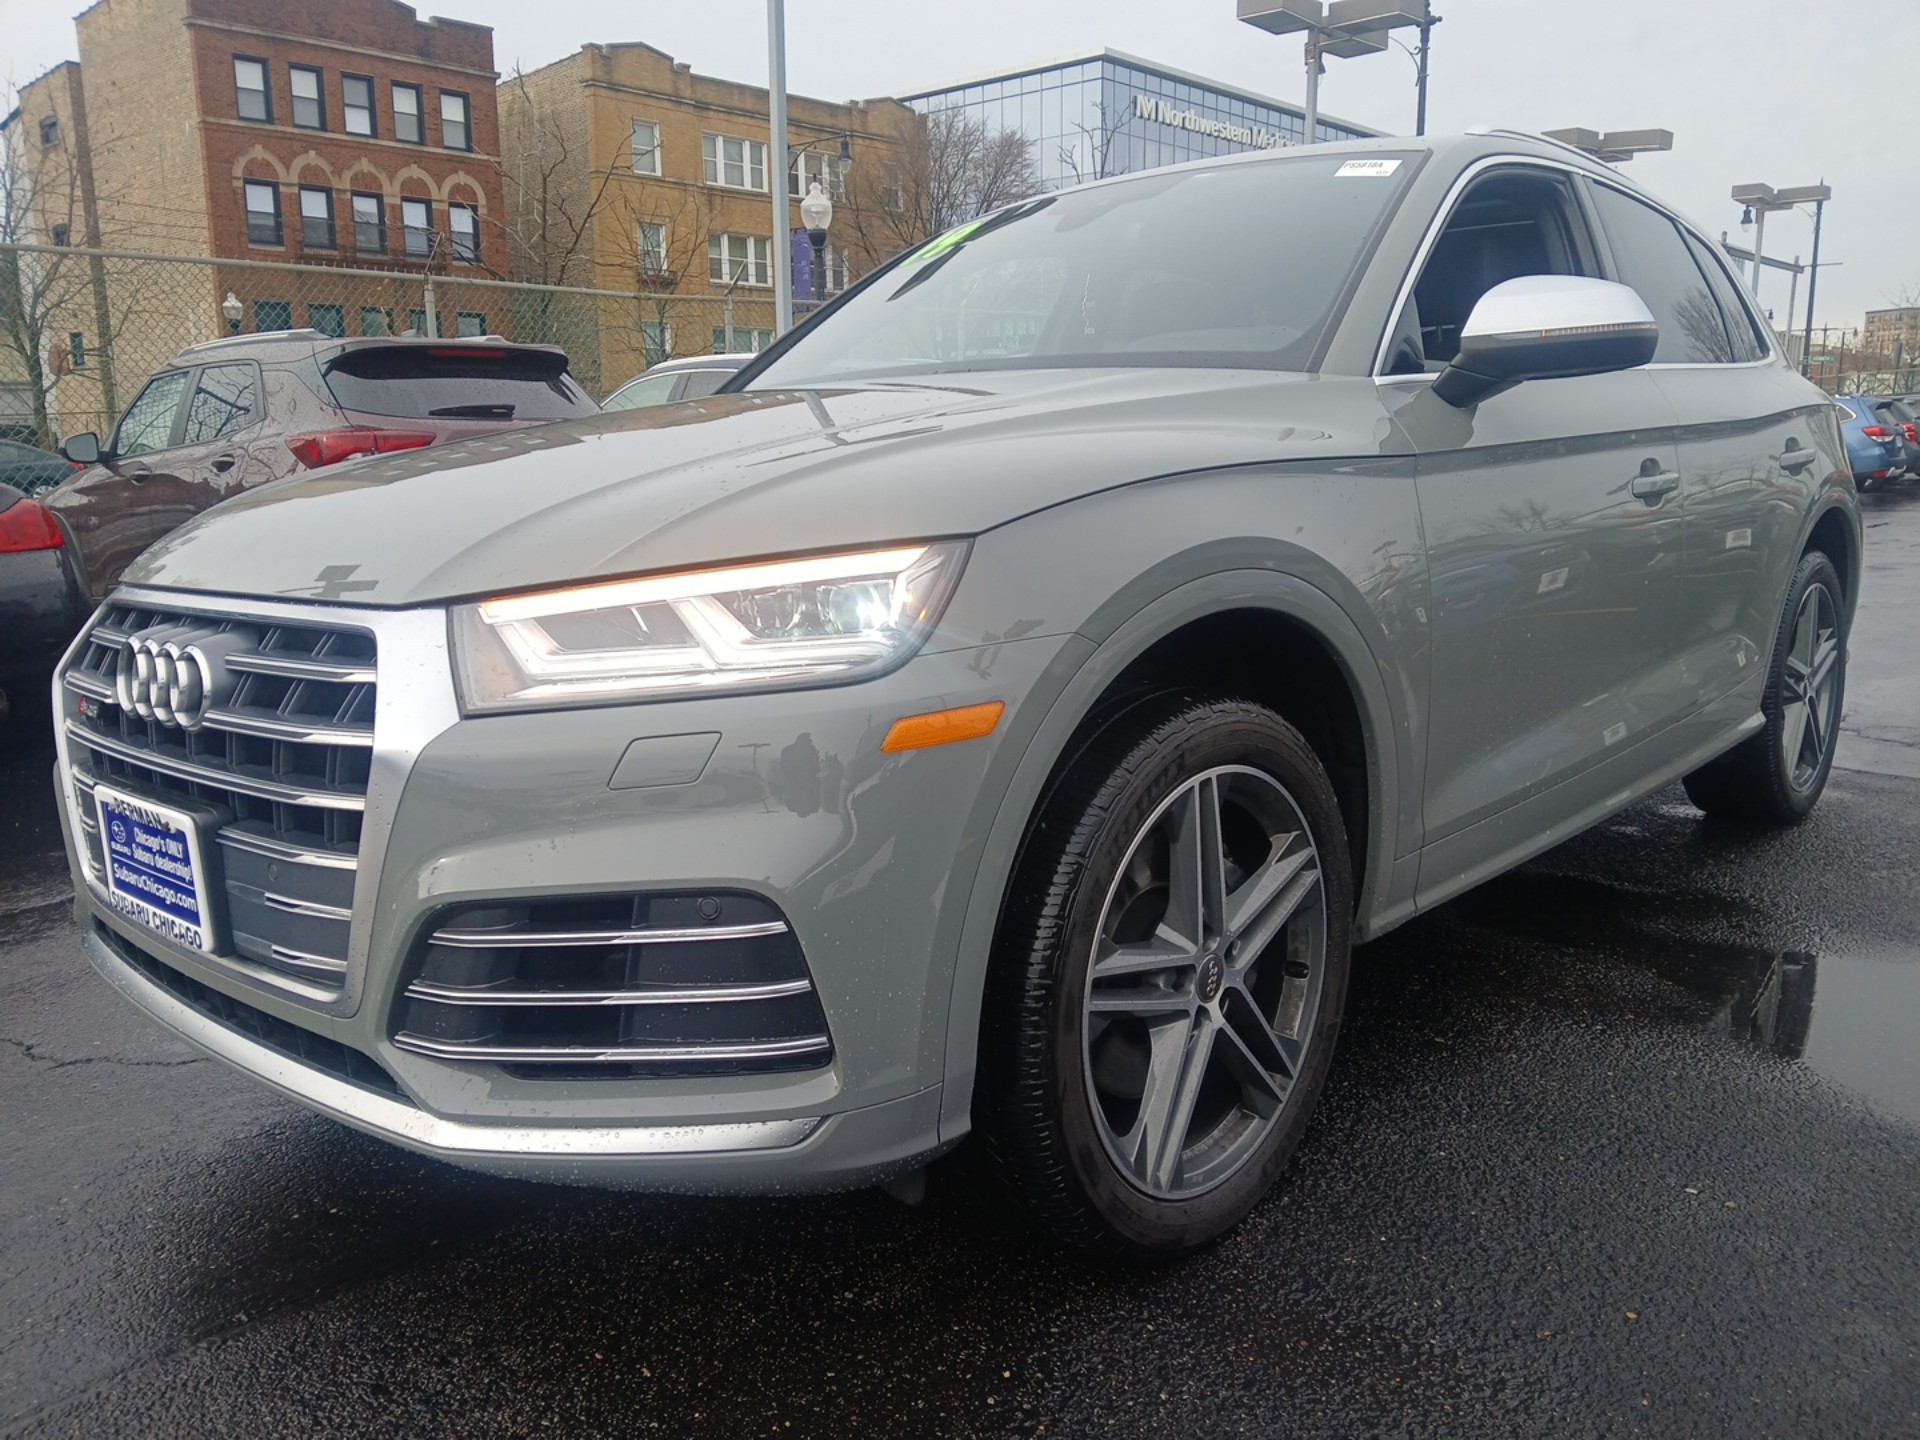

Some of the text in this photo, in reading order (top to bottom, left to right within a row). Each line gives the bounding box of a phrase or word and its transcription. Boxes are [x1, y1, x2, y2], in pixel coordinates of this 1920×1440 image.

[1158, 101, 1252, 146] Northwestern
[131, 843, 155, 866] Subaru
[133, 826, 184, 859] Chicago's ONLY
[113, 862, 197, 912] SubaruChicago.com
[111, 890, 203, 949] SUBARU CHICAGO
